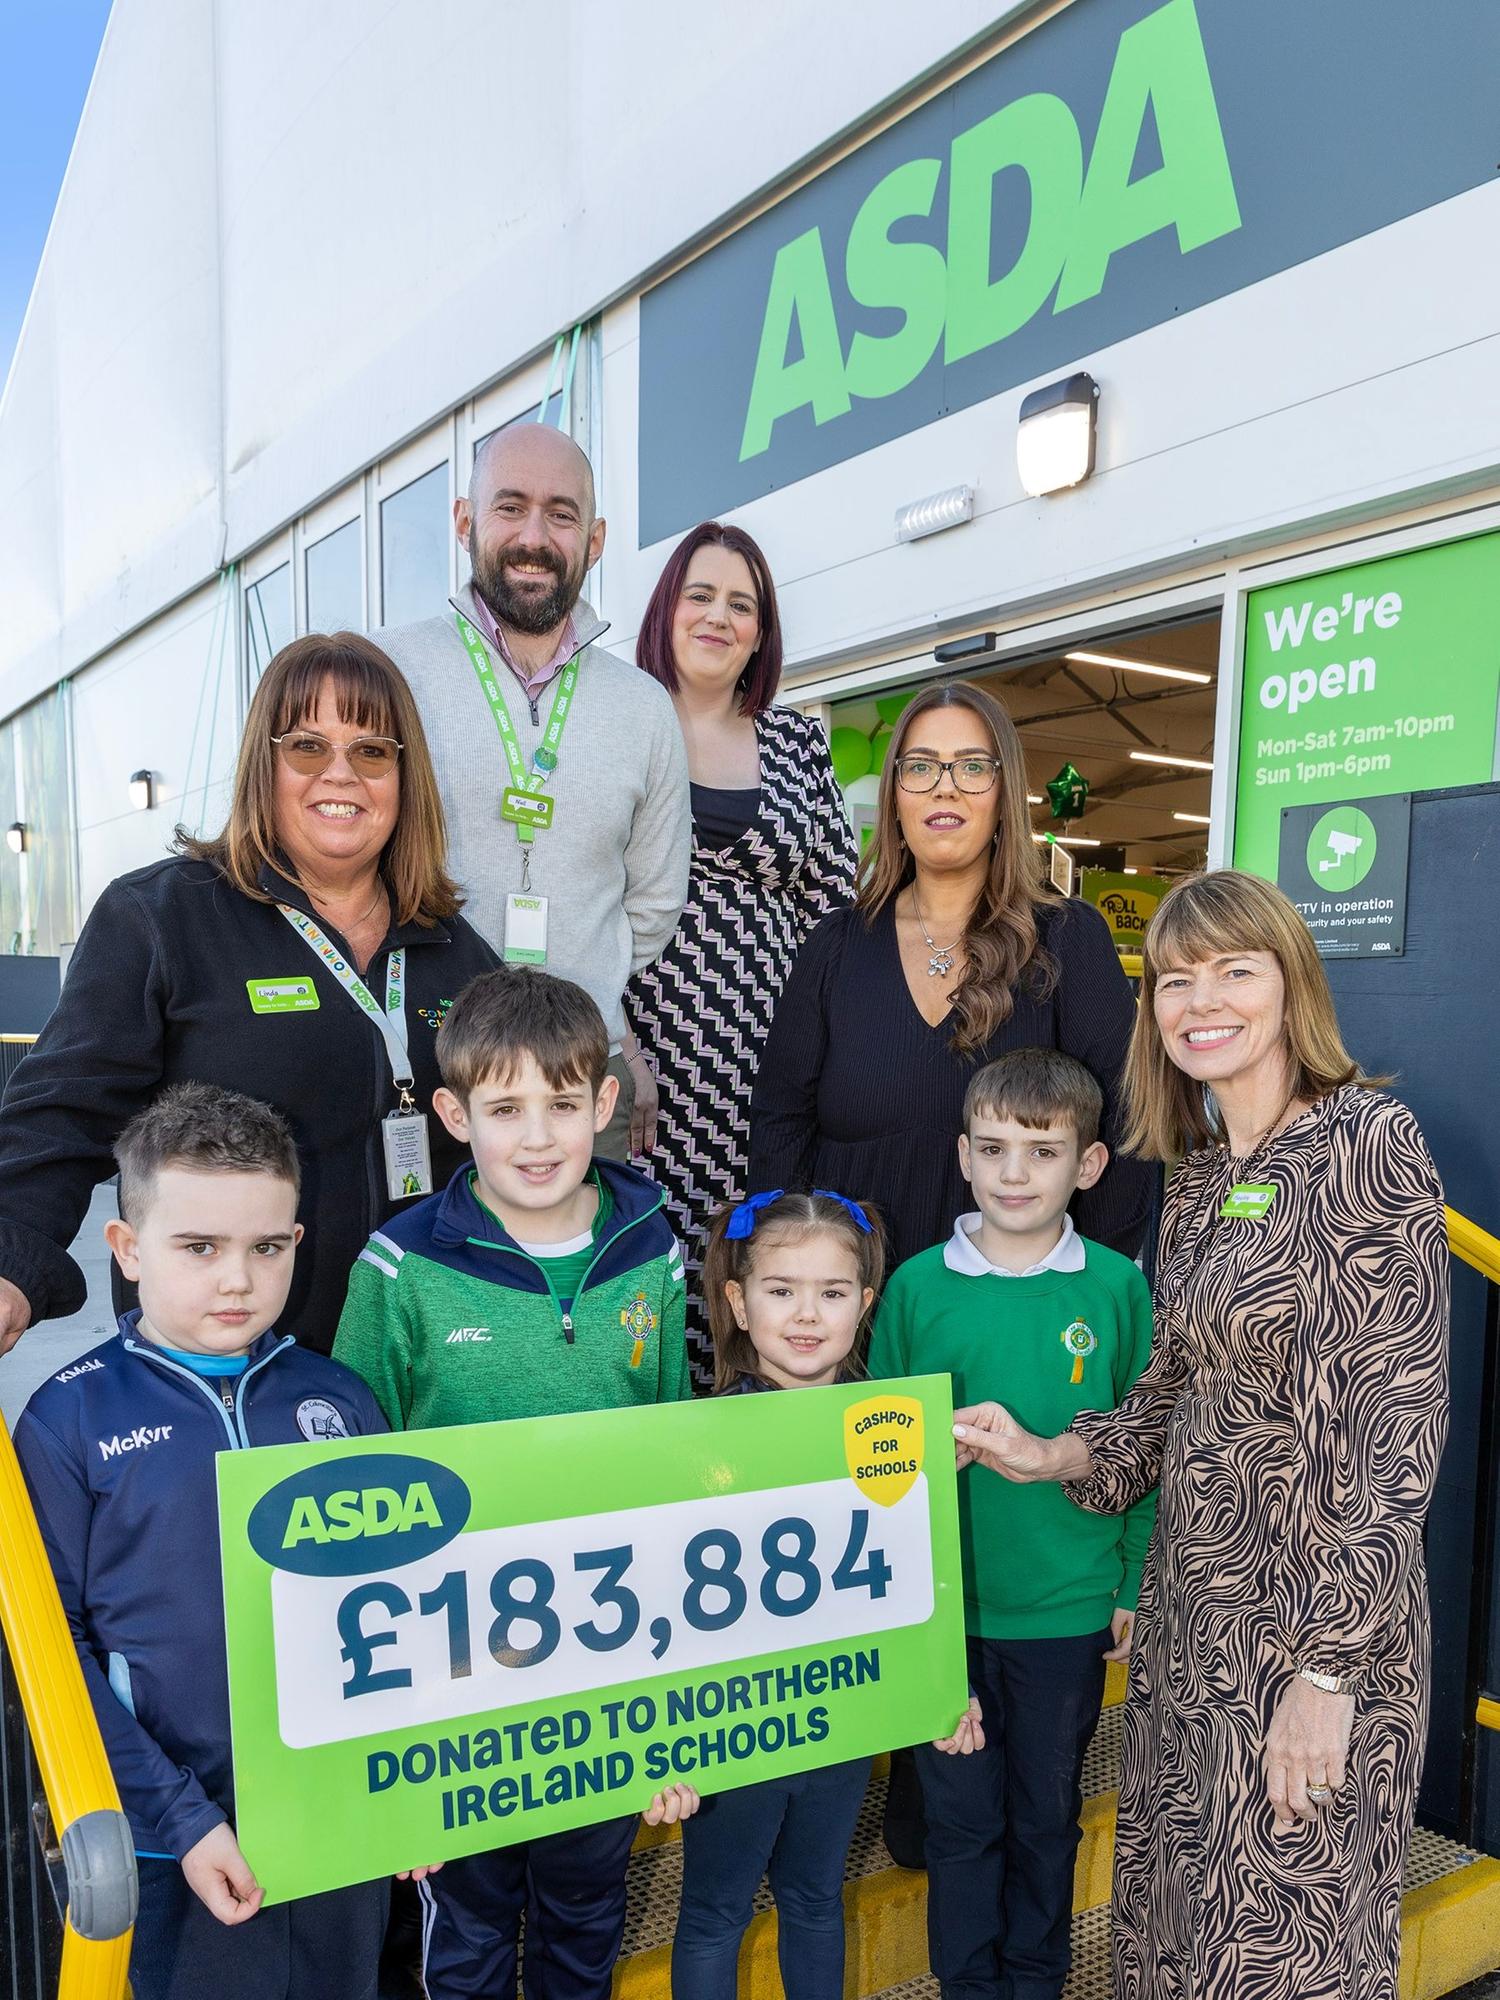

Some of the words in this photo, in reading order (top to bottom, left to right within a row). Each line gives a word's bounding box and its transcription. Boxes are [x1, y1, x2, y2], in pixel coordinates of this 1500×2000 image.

[738, 0, 1243, 462] ASDA
[463, 626, 477, 647] ASDA
[473, 652, 488, 673] ASDA
[484, 680, 499, 702] ASDA
[1260, 656, 1376, 714] open
[496, 708, 510, 733] ASDA
[1257, 729, 1336, 758] Mon-Sat
[1342, 713, 1455, 746] 7am-10pm
[507, 740, 519, 765] ASDA
[1255, 767, 1290, 786] Sun
[1296, 753, 1391, 783] 1pm-6pm
[1295, 902, 1318, 914] CTV
[1321, 901, 1331, 913] in
[1335, 898, 1394, 914] operation
[1306, 918, 1329, 928] curity
[1330, 917, 1345, 926] and
[1347, 917, 1366, 927] your
[1367, 915, 1393, 925] safety
[293, 914, 352, 979] COMMUNITY
[1371, 942, 1391, 951] ASDA
[390, 949, 401, 985] AMPION
[872, 1438, 899, 1454] FOR
[856, 1459, 917, 1480] SCHOOLS
[281, 1481, 443, 1550] ASDA
[336, 1508, 894, 1700] £183,884
[601, 1696, 656, 1740] TO
[644, 1706, 830, 1781] SCHOOLS
